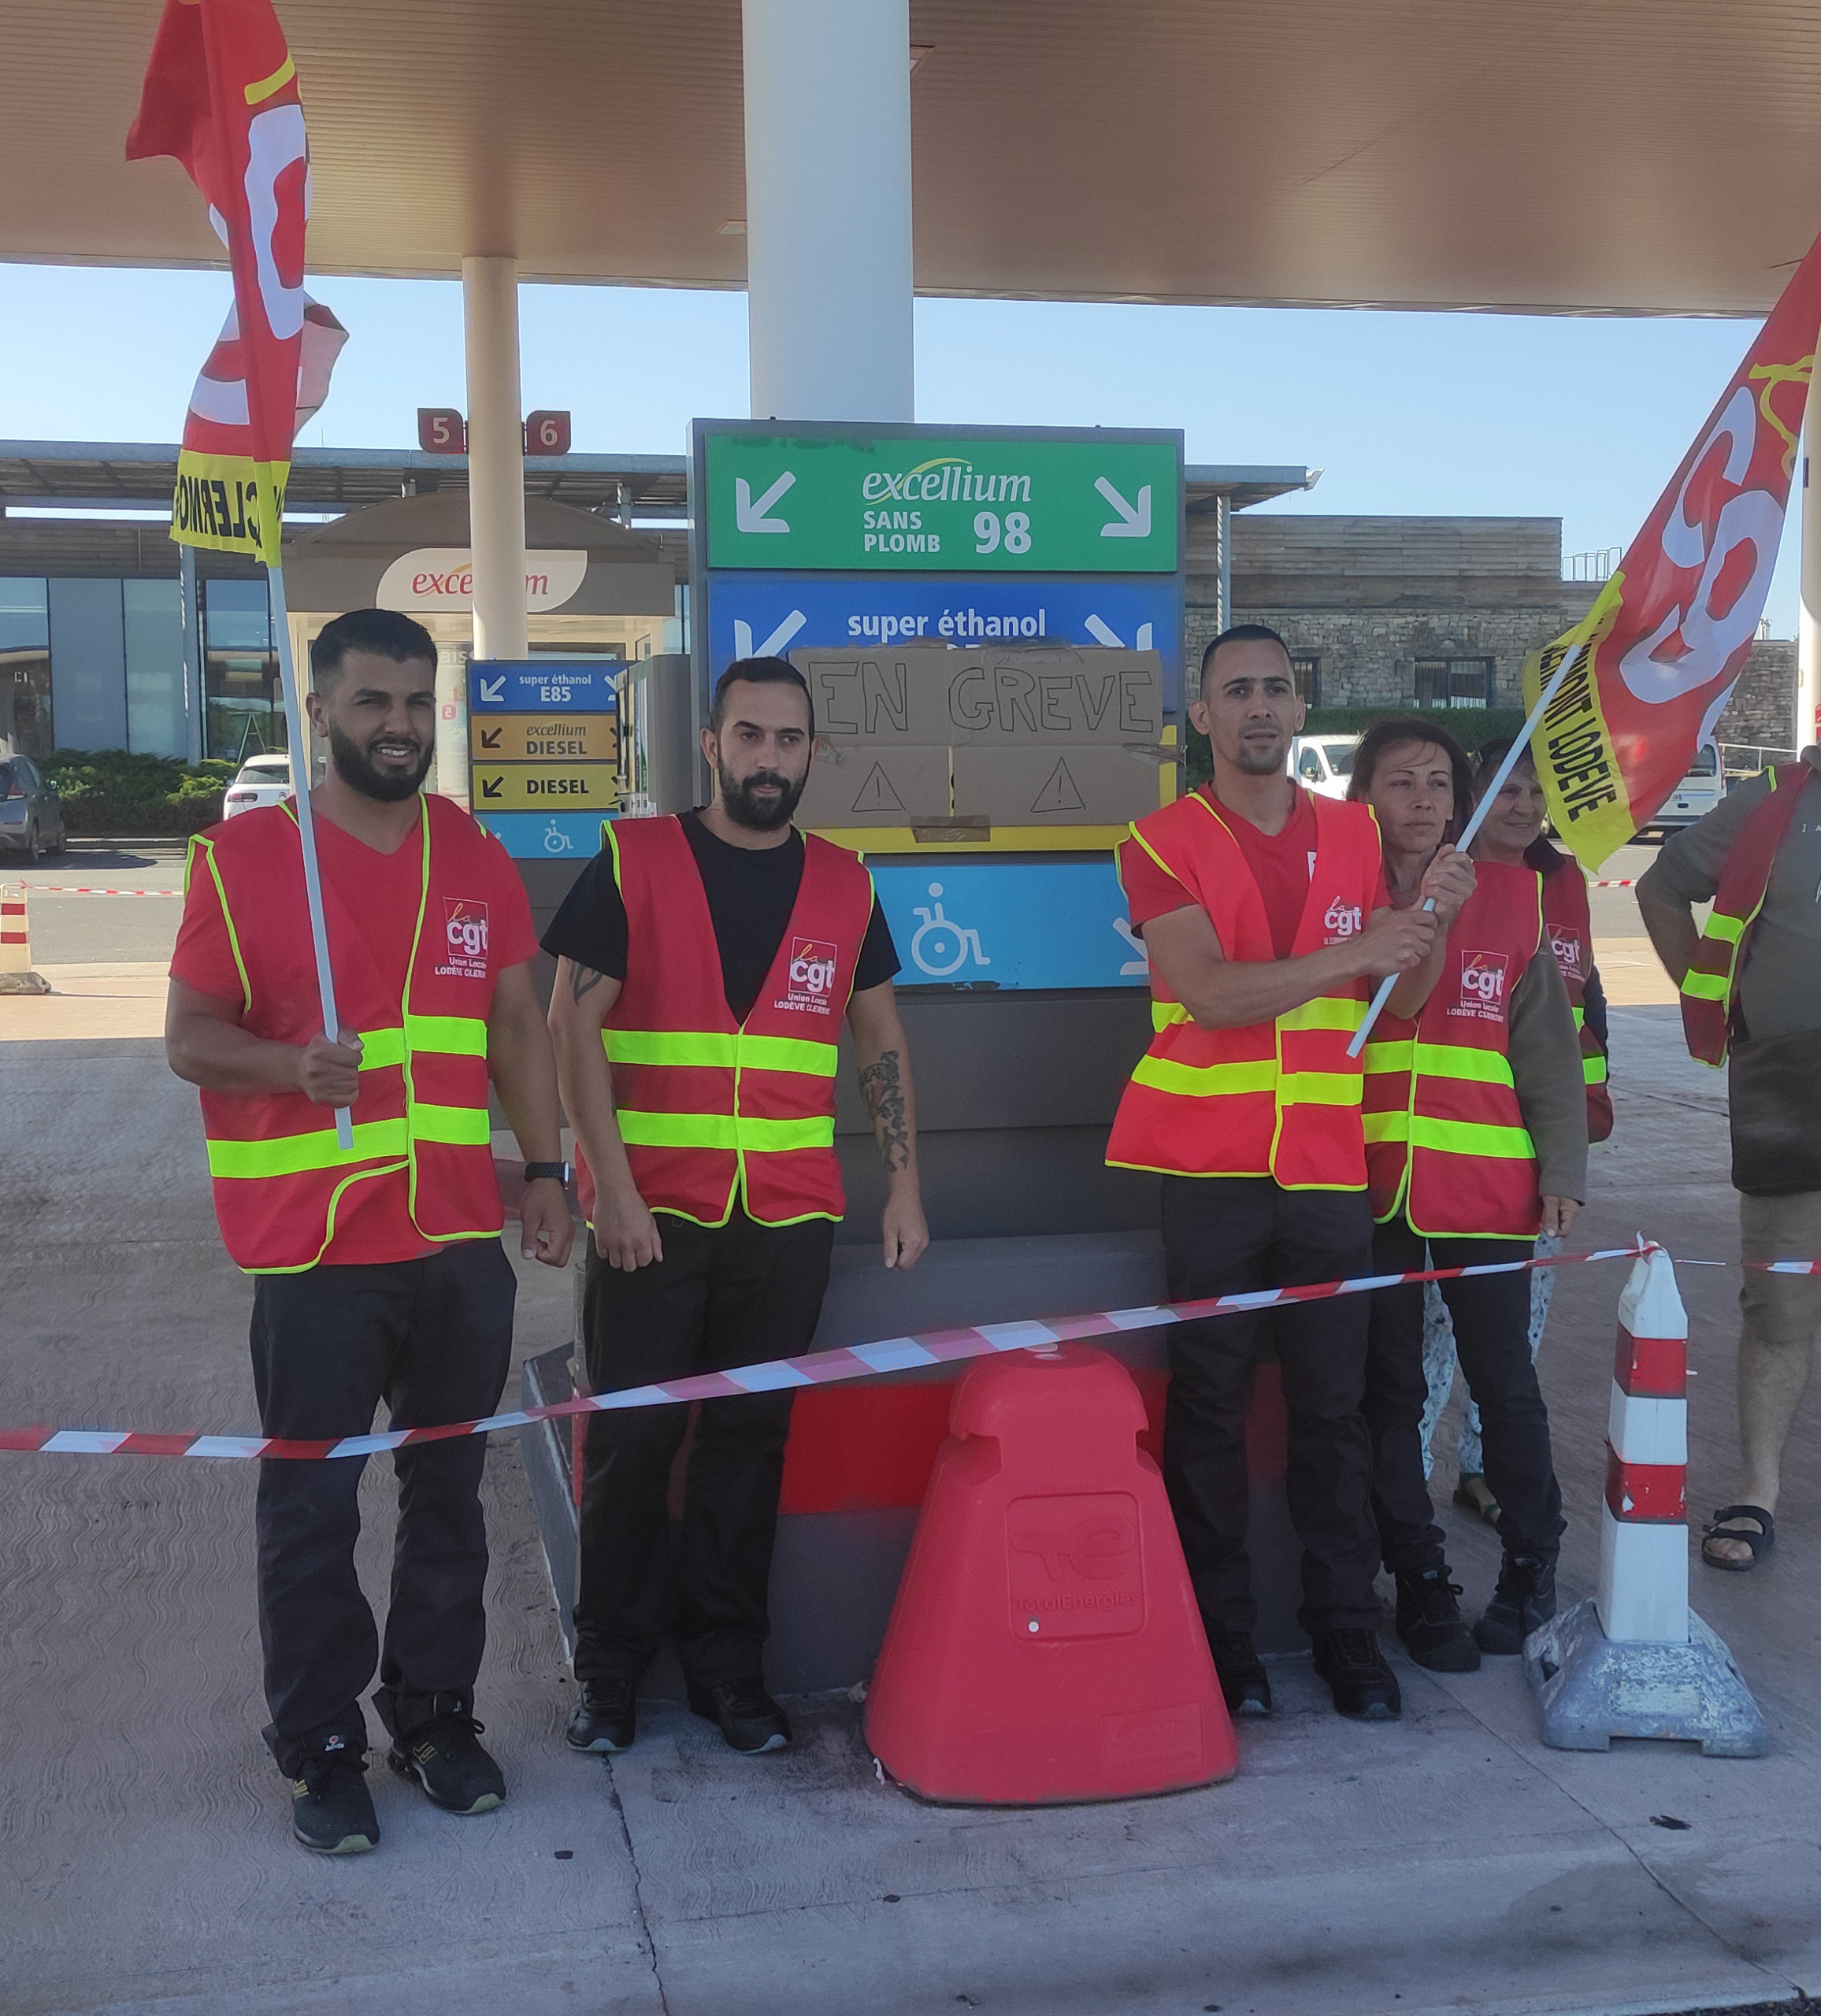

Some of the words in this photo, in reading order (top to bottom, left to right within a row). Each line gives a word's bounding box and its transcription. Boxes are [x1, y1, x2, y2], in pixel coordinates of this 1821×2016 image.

[432, 417, 450, 443] 5
[540, 420, 558, 447] 6
[862, 465, 1032, 502] excellium
[863, 511, 922, 529] SANS
[863, 534, 941, 553] PLOMB
[974, 511, 1032, 554] 98
[848, 614, 929, 643] super
[938, 608, 1046, 636] éthanol
[519, 676, 549, 687] super
[551, 674, 592, 684] éthanol
[540, 686, 572, 702] E85
[809, 662, 908, 735] EN
[949, 668, 1153, 732] GREVE
[526, 724, 586, 736] excellium
[526, 741, 588, 754] DIESEL
[527, 780, 589, 794] DIESEL
[1324, 906, 1361, 936] cgt
[447, 919, 488, 954] cgt
[449, 957, 468, 967] Union
[1551, 939, 1580, 963] cgt
[790, 960, 835, 992] cgt
[1463, 969, 1504, 999] cgt
[788, 993, 810, 1002] Union
[1460, 1000, 1482, 1009] Union
[1015, 1591, 1140, 1612] TotalEnergies
